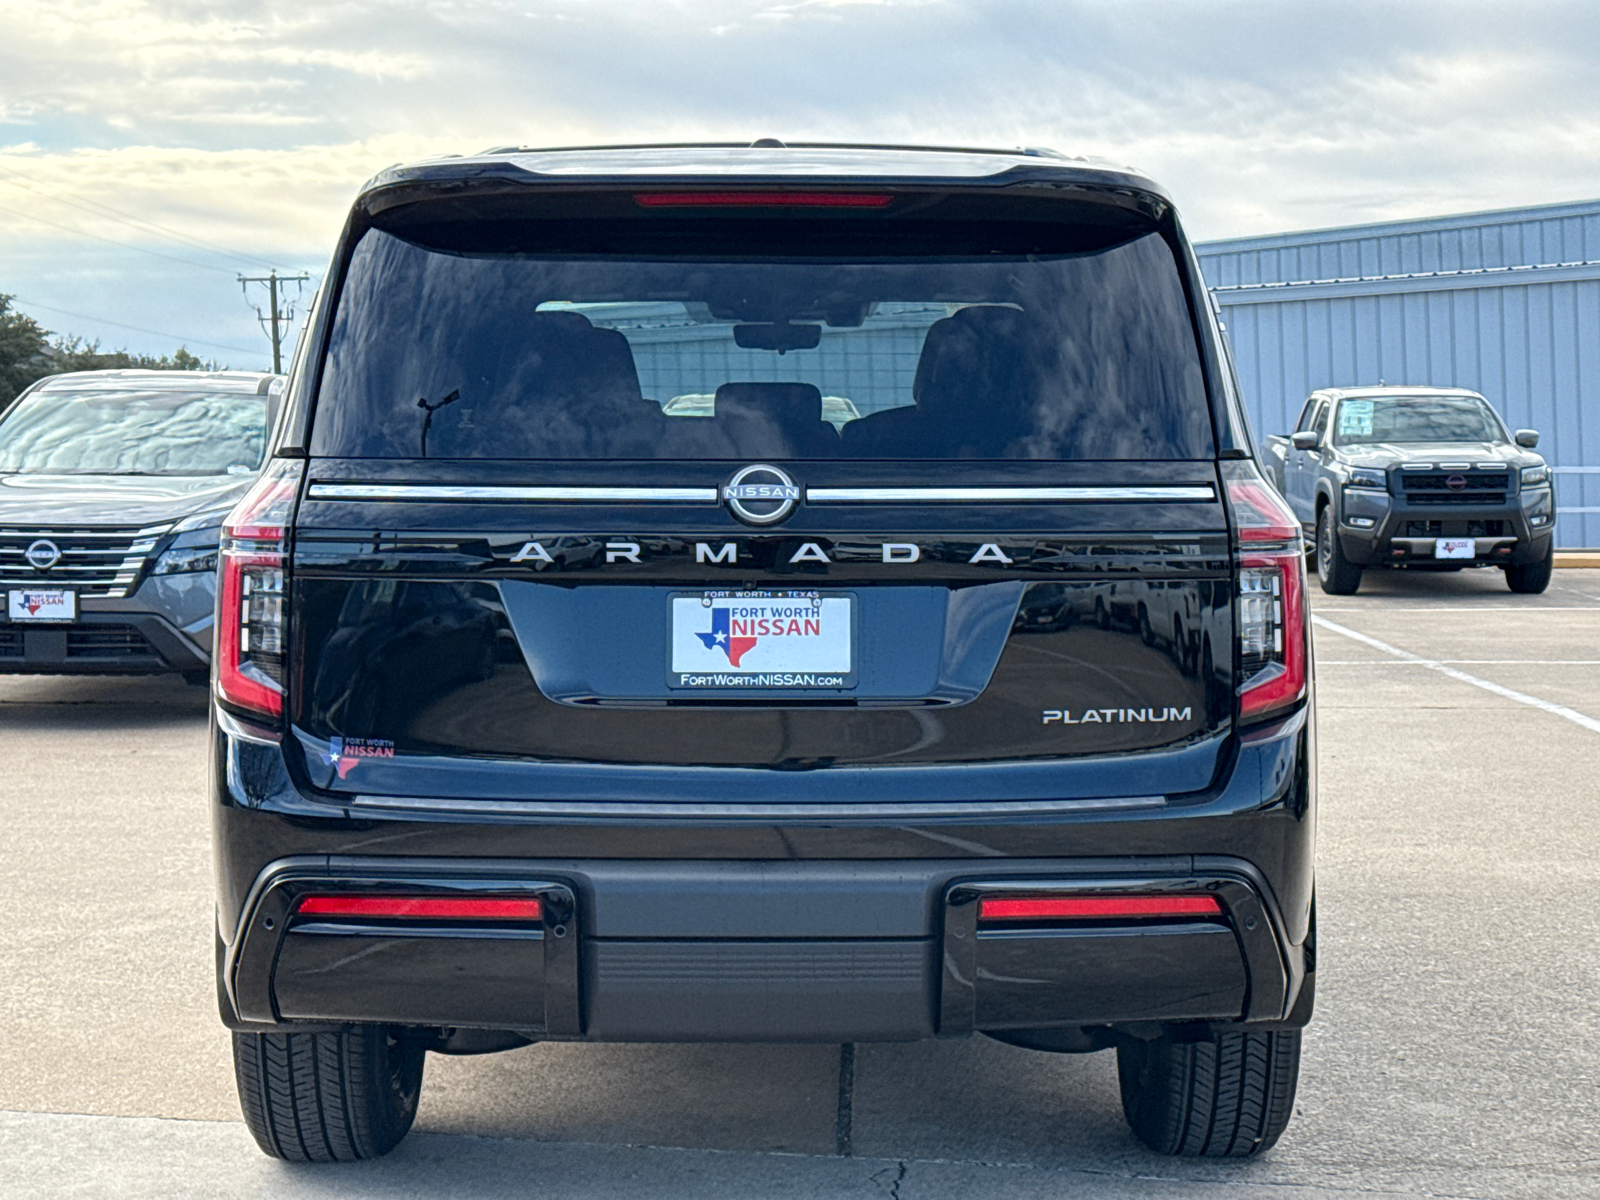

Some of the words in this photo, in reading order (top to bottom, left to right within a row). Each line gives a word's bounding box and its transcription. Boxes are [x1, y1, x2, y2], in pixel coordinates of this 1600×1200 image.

[725, 487, 798, 498] NISSAN
[509, 542, 1014, 564] ARMADA
[704, 590, 730, 598] FORT
[735, 590, 771, 598] WORTH
[787, 590, 820, 598] TEXAS
[731, 607, 767, 618] FORT
[771, 607, 820, 618] WORTH
[731, 619, 820, 636] NISSAN
[1042, 707, 1192, 724] PLATINUM
[345, 737, 365, 745] FORT
[366, 739, 395, 747] WORTH
[344, 745, 395, 758] NISSAN
